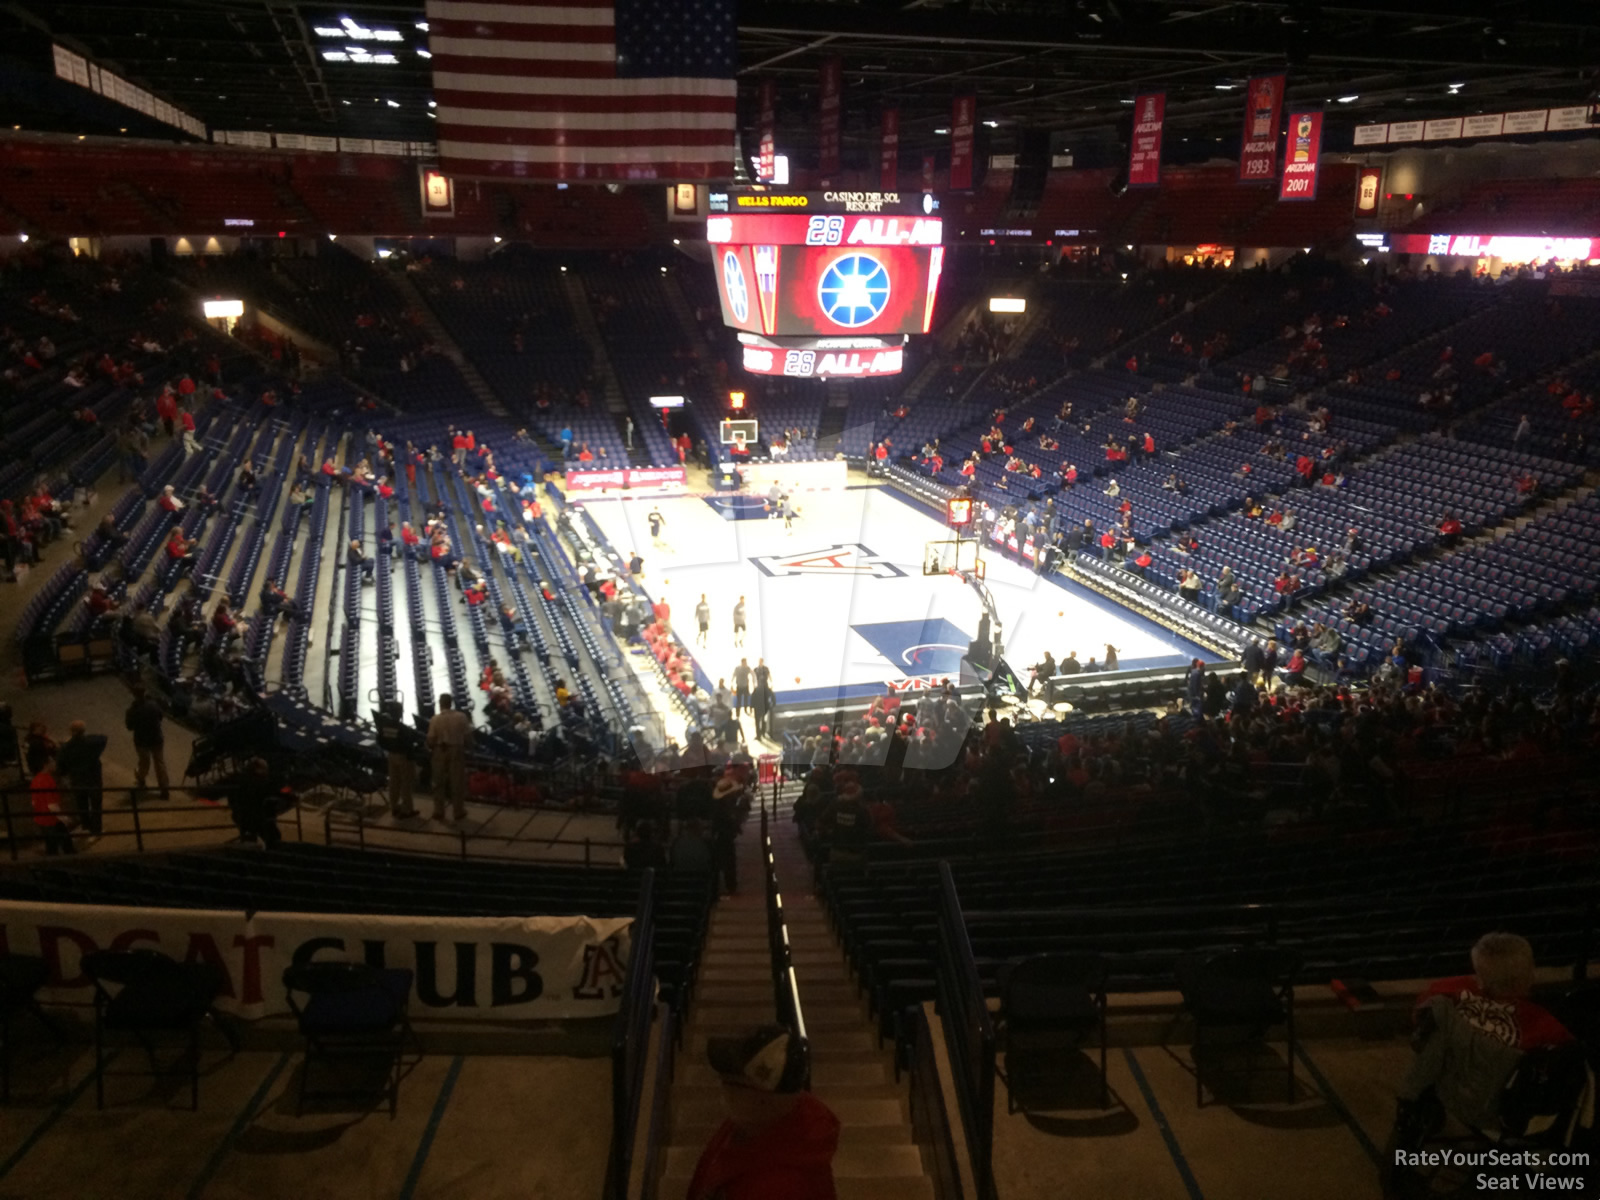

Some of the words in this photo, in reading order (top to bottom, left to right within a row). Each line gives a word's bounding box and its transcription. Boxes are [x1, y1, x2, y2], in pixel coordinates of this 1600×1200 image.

[1243, 141, 1276, 153] ARIZONA
[1246, 159, 1269, 175] 1993
[1285, 162, 1315, 173] ARIZONA
[1286, 178, 1309, 192] 2001
[737, 196, 769, 207] WELLS
[770, 196, 808, 207] FARGO
[823, 191, 864, 202] CASINO
[865, 192, 883, 202] DEL
[883, 193, 901, 204] SOL
[845, 201, 883, 212] RESORT
[806, 215, 845, 246] 28
[784, 350, 816, 377] 28
